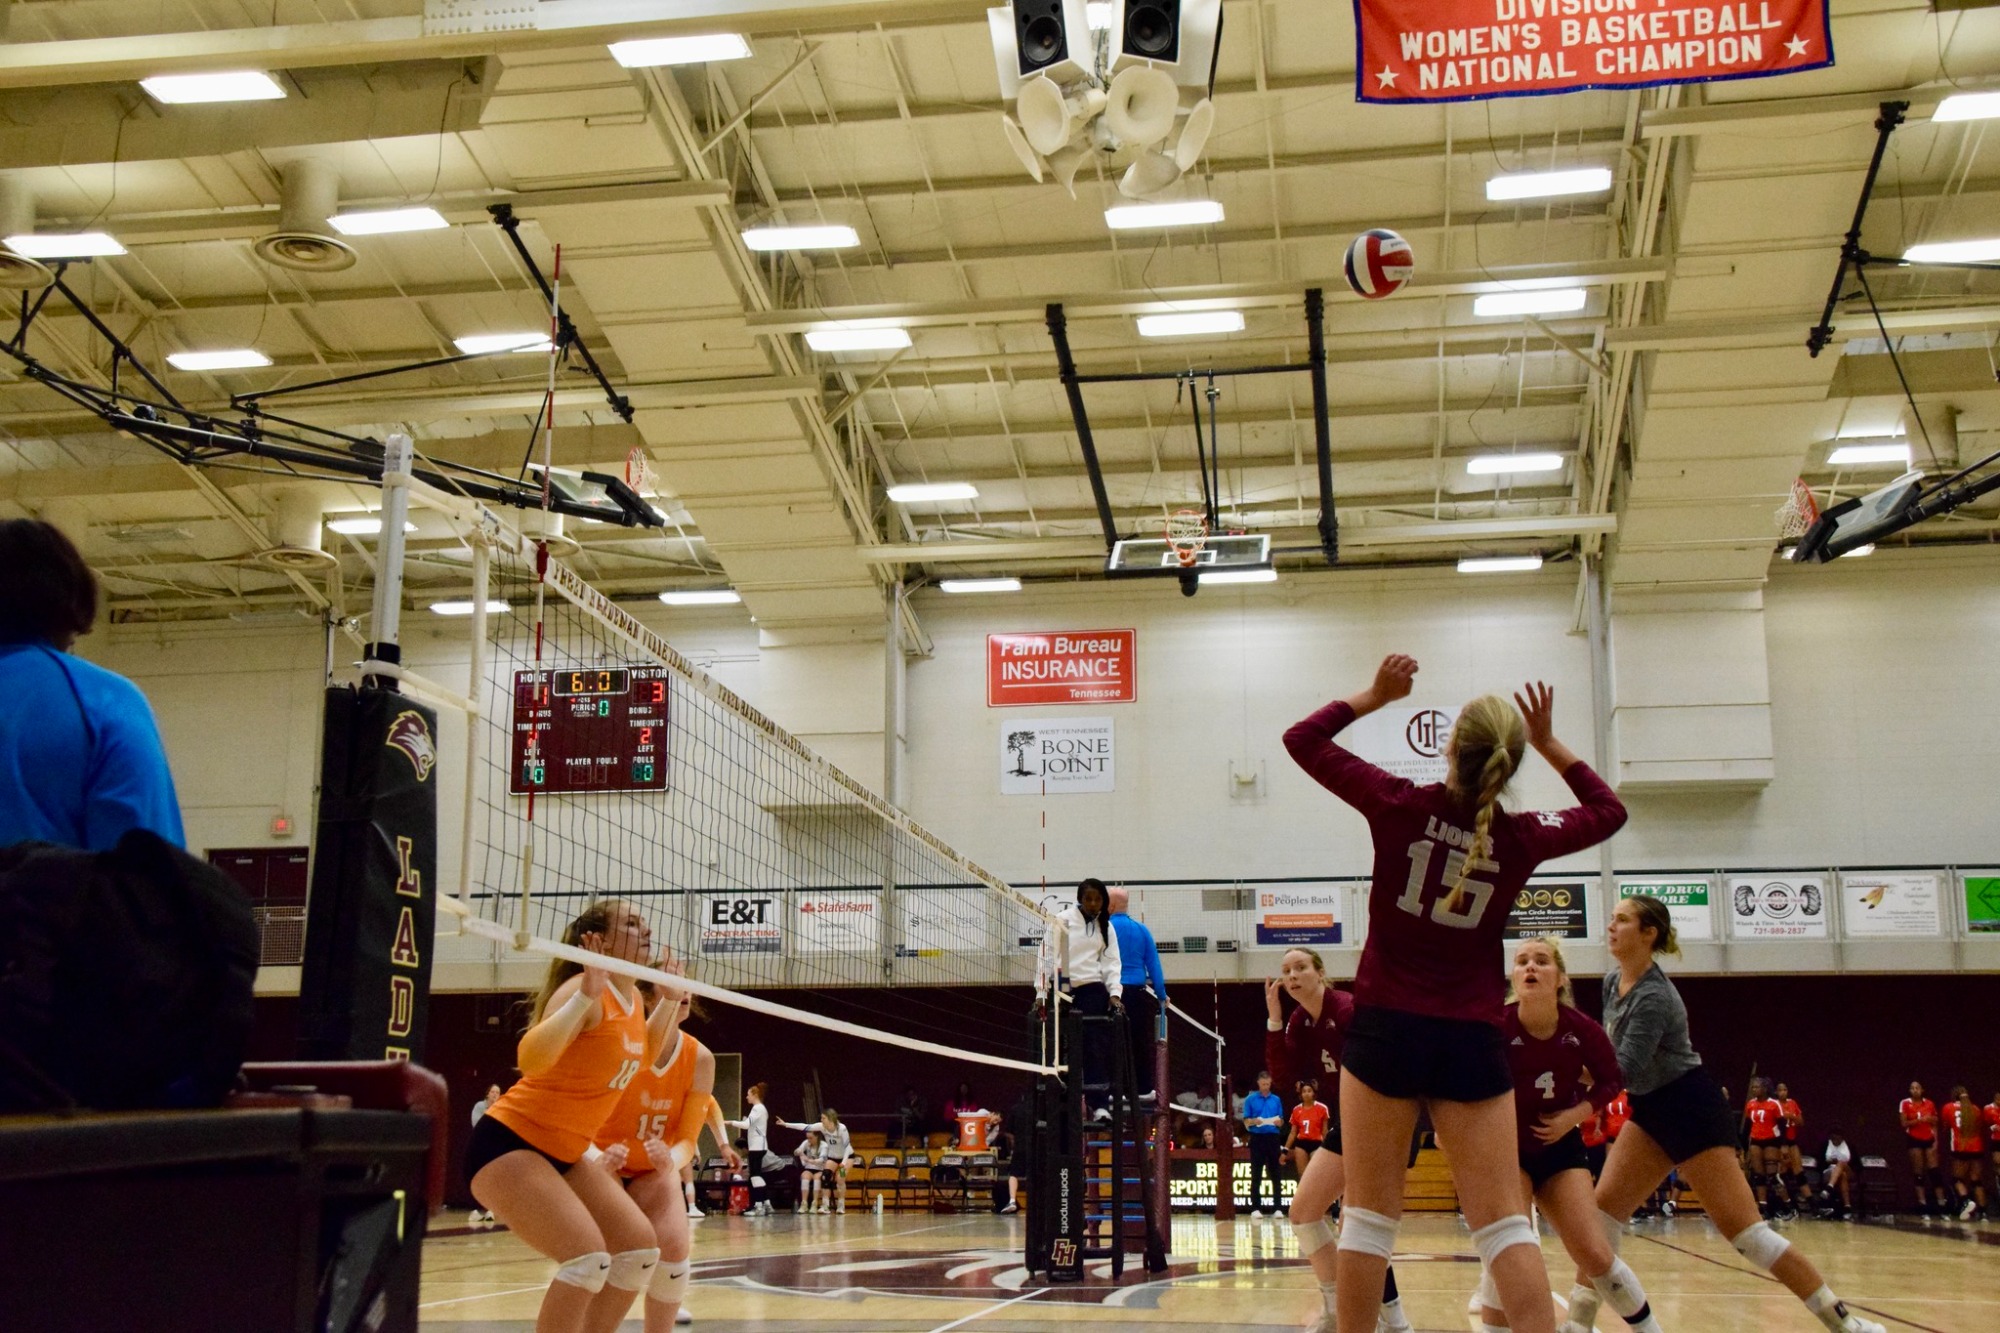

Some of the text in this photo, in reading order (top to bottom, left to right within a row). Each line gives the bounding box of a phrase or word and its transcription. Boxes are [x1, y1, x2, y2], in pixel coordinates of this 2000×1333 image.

[1400, 2, 1783, 61] WOMEN'S BASKETBALL
[1419, 35, 1763, 91] NATIONAL CHAMPION
[1001, 637, 1122, 656] Farm Bureau
[631, 669, 667, 679] VISITOR
[1002, 658, 1120, 680] INSURANCE
[520, 672, 548, 683] HOE
[652, 682, 663, 702] 3
[1070, 688, 1121, 698] Tennessee
[529, 710, 552, 718] BNUS
[571, 703, 597, 711] PERIOD
[599, 700, 609, 716] 0
[517, 723, 551, 731] TIMEUTS
[629, 719, 664, 727] TIMEOUTS
[640, 728, 651, 744] 2
[638, 745, 654, 753] LEFT
[1042, 738, 1110, 754] BONE
[596, 757, 618, 765] FOULS
[1040, 757, 1110, 777] JOINT
[534, 768, 544, 784] 0
[1396, 839, 1499, 930] 15
[1622, 885, 1706, 895] CITY DRUG
[1275, 895, 1335, 907] Peoples Bank
[1657, 895, 1690, 904] ORE
[712, 899, 772, 925] E&T
[704, 930, 779, 938] CONTRACTING
[386, 836, 421, 1061] LAD
[1321, 1049, 1338, 1073] 5
[608, 1059, 640, 1090] 18
[1534, 1071, 1556, 1100] 4
[636, 1113, 668, 1140] 15
[964, 1122, 976, 1135] G
[1302, 1119, 1310, 1134] 7
[1196, 1163, 1267, 1178] BRWE
[1169, 1180, 1218, 1195] SPORT
[1060, 1168, 1069, 1234] sports imports
